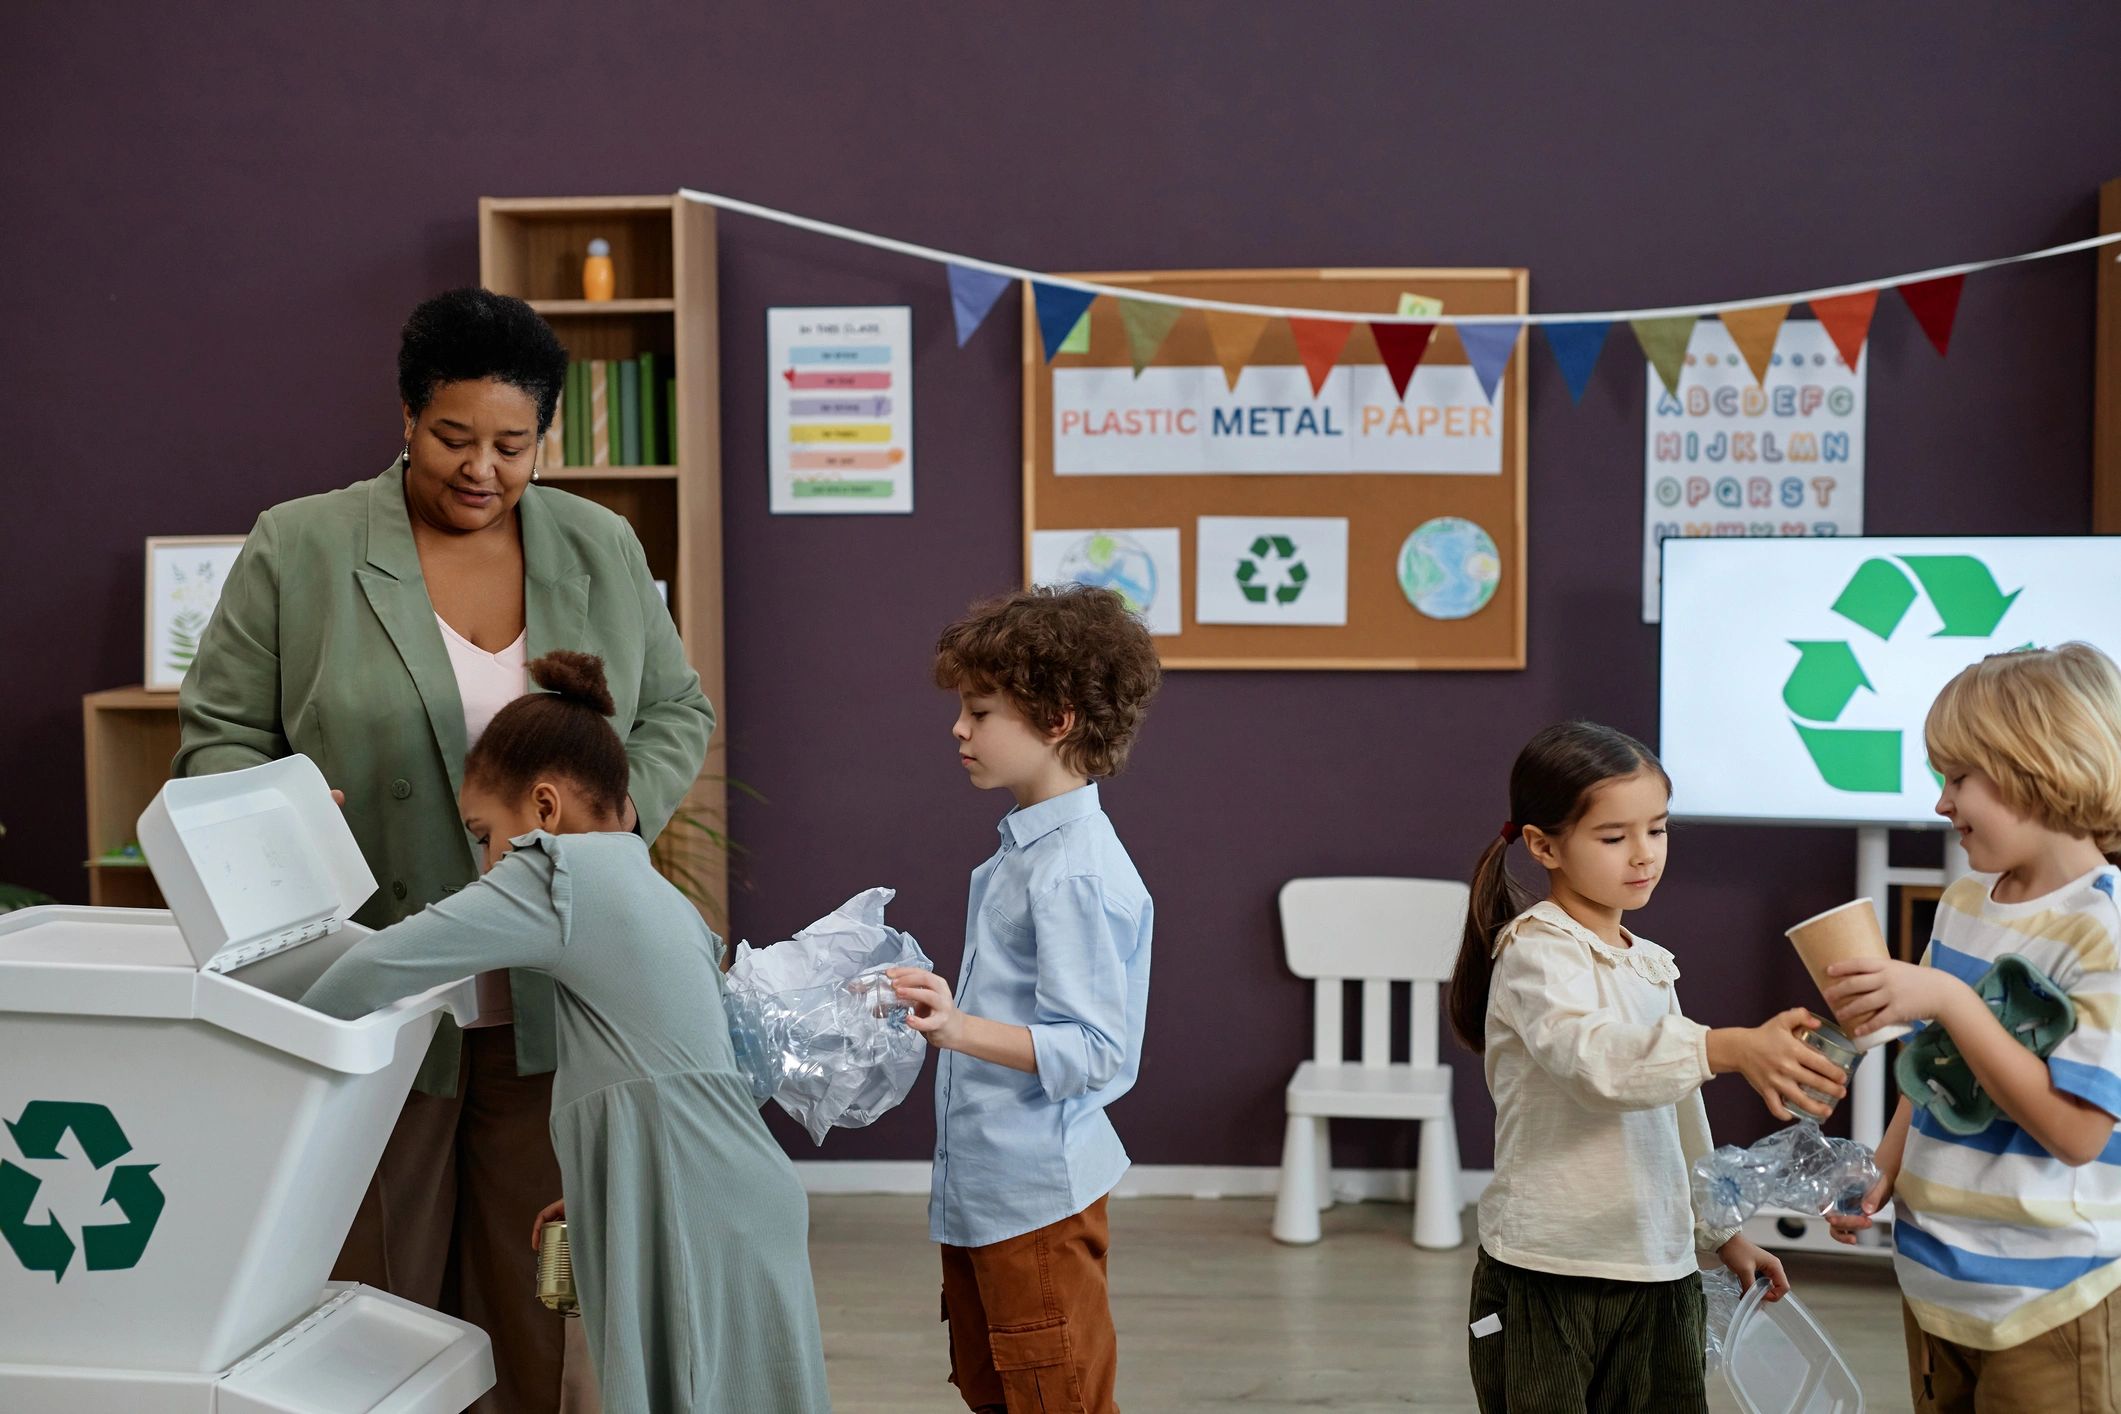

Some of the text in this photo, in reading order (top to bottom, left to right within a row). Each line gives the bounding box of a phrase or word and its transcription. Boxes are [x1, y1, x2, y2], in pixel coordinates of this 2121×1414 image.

[1062, 406, 1494, 437] PLASTIC METAL PAPER
